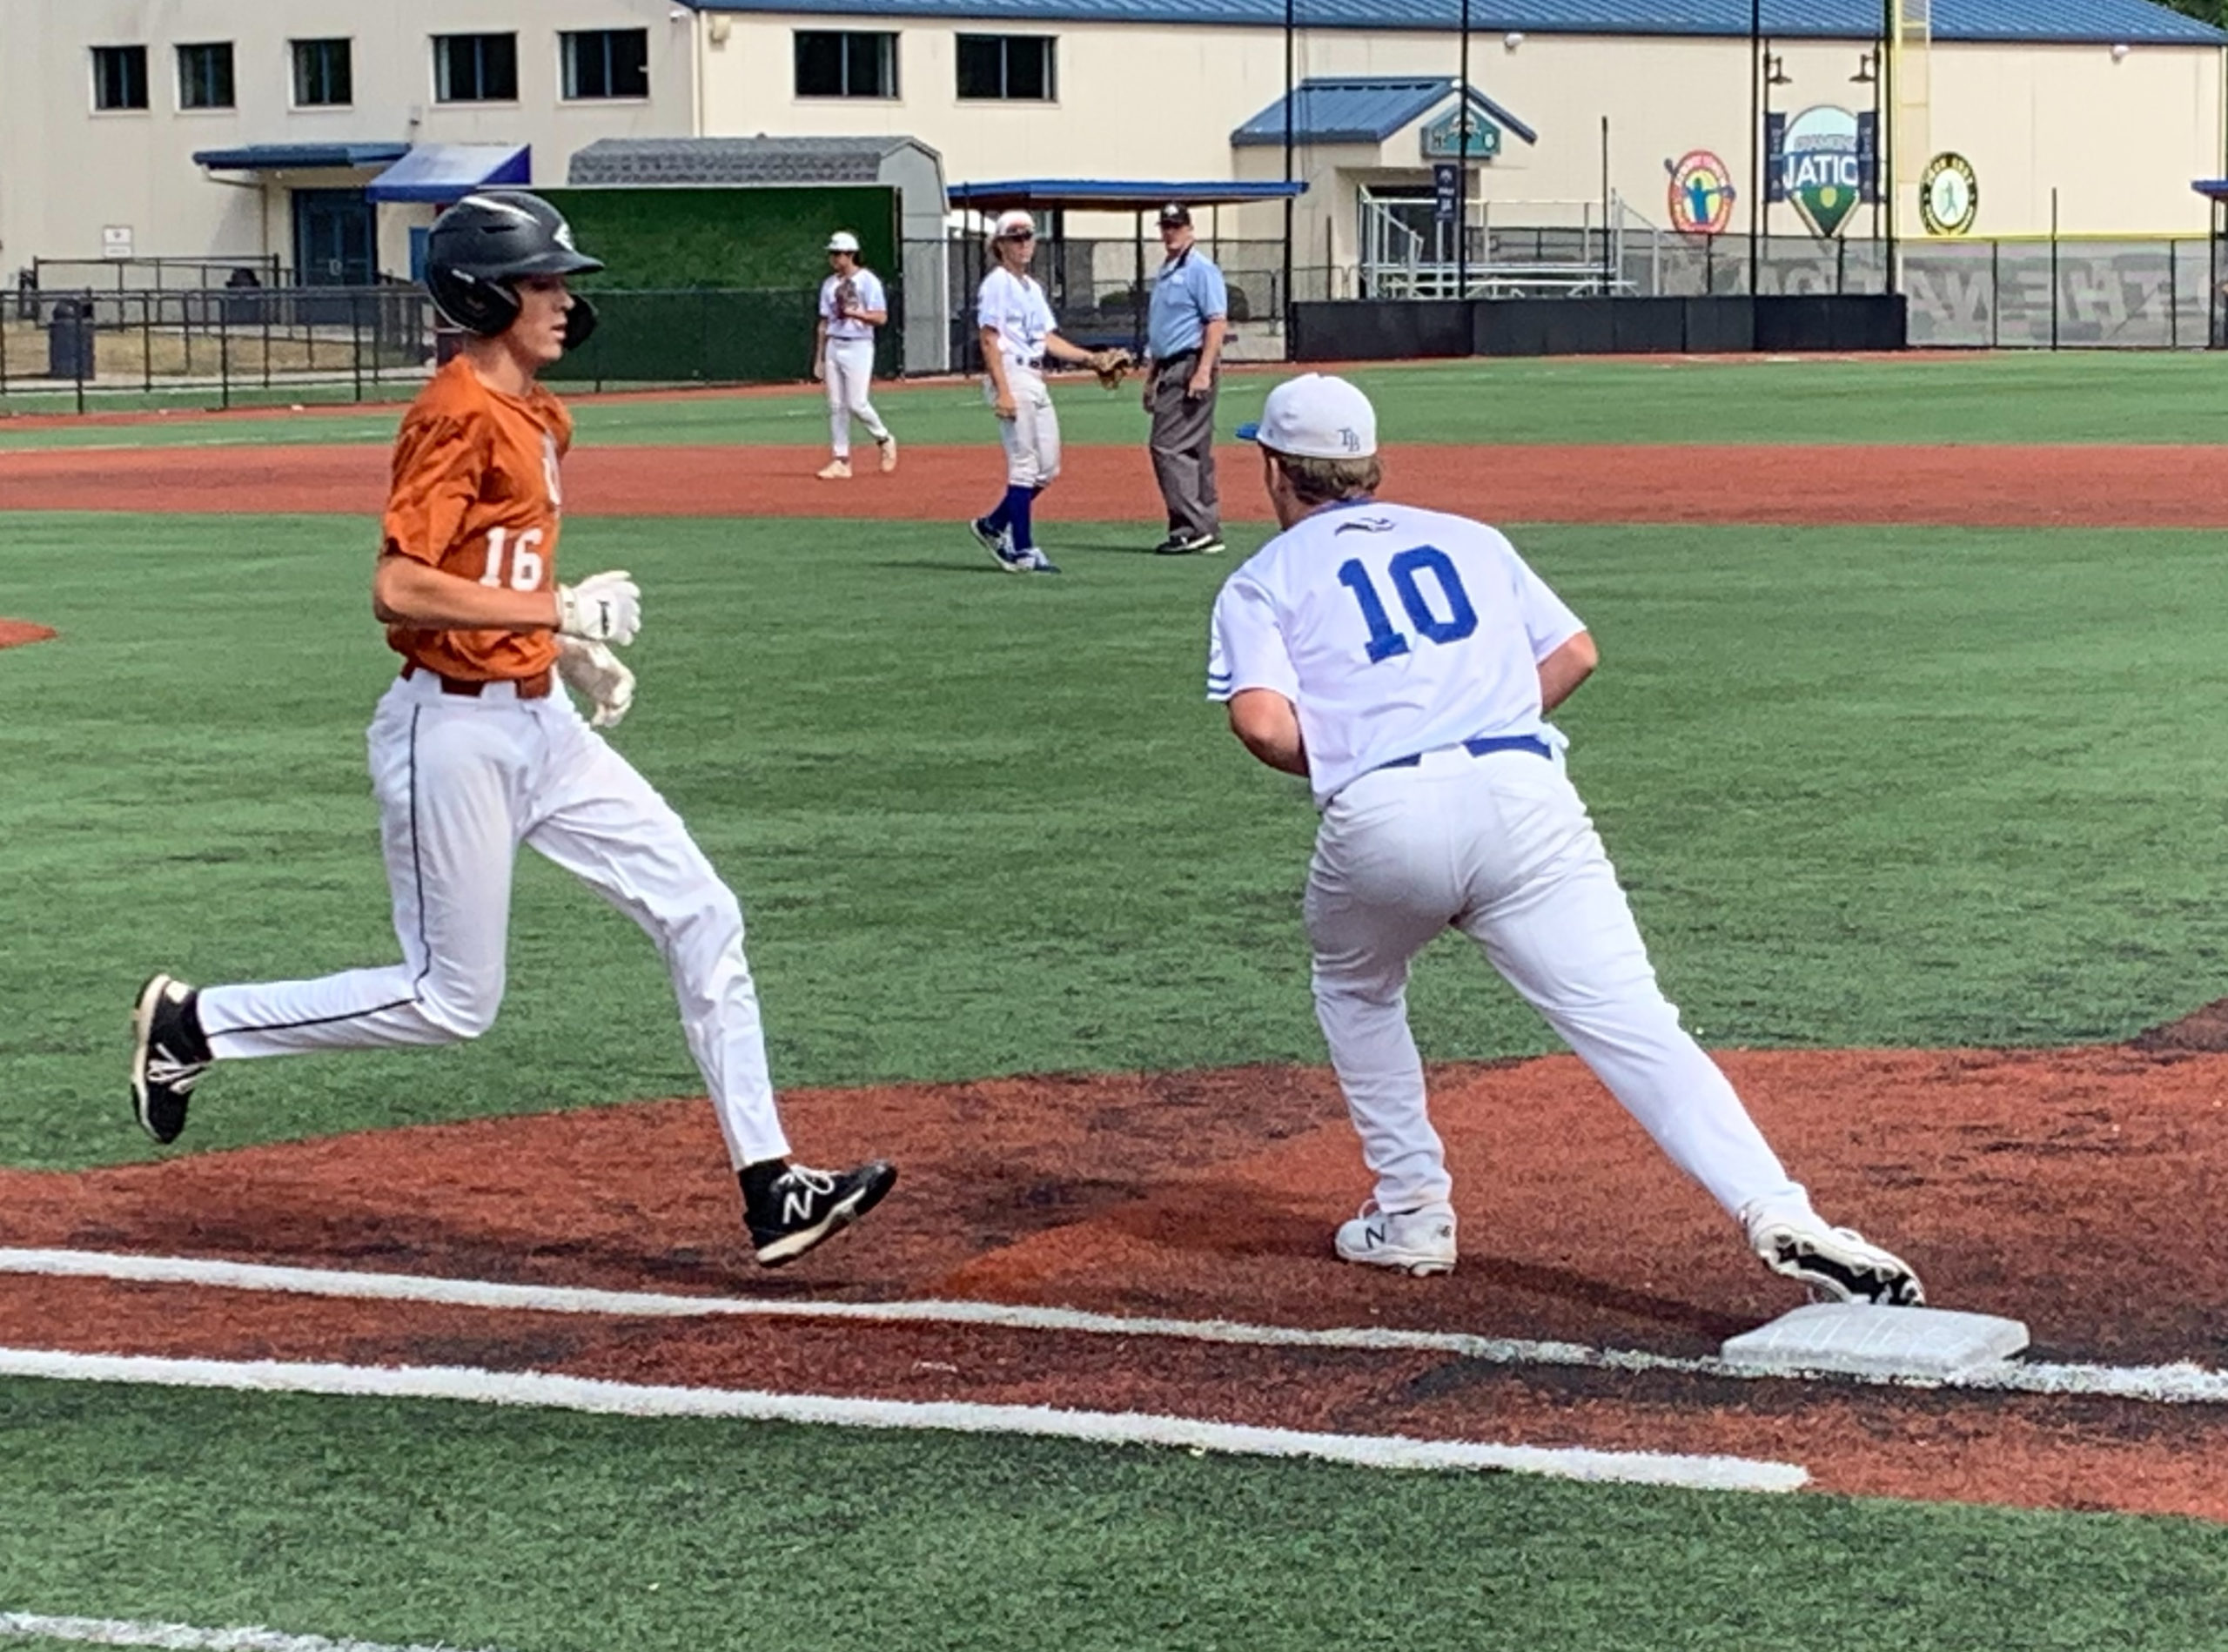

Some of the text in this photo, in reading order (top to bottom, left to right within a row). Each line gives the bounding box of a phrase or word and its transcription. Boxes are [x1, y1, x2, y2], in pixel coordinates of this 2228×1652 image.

[1337, 427, 1360, 453] TB
[478, 526, 543, 591] 16
[1337, 545, 1478, 664] 10
[782, 1189, 813, 1225] N
